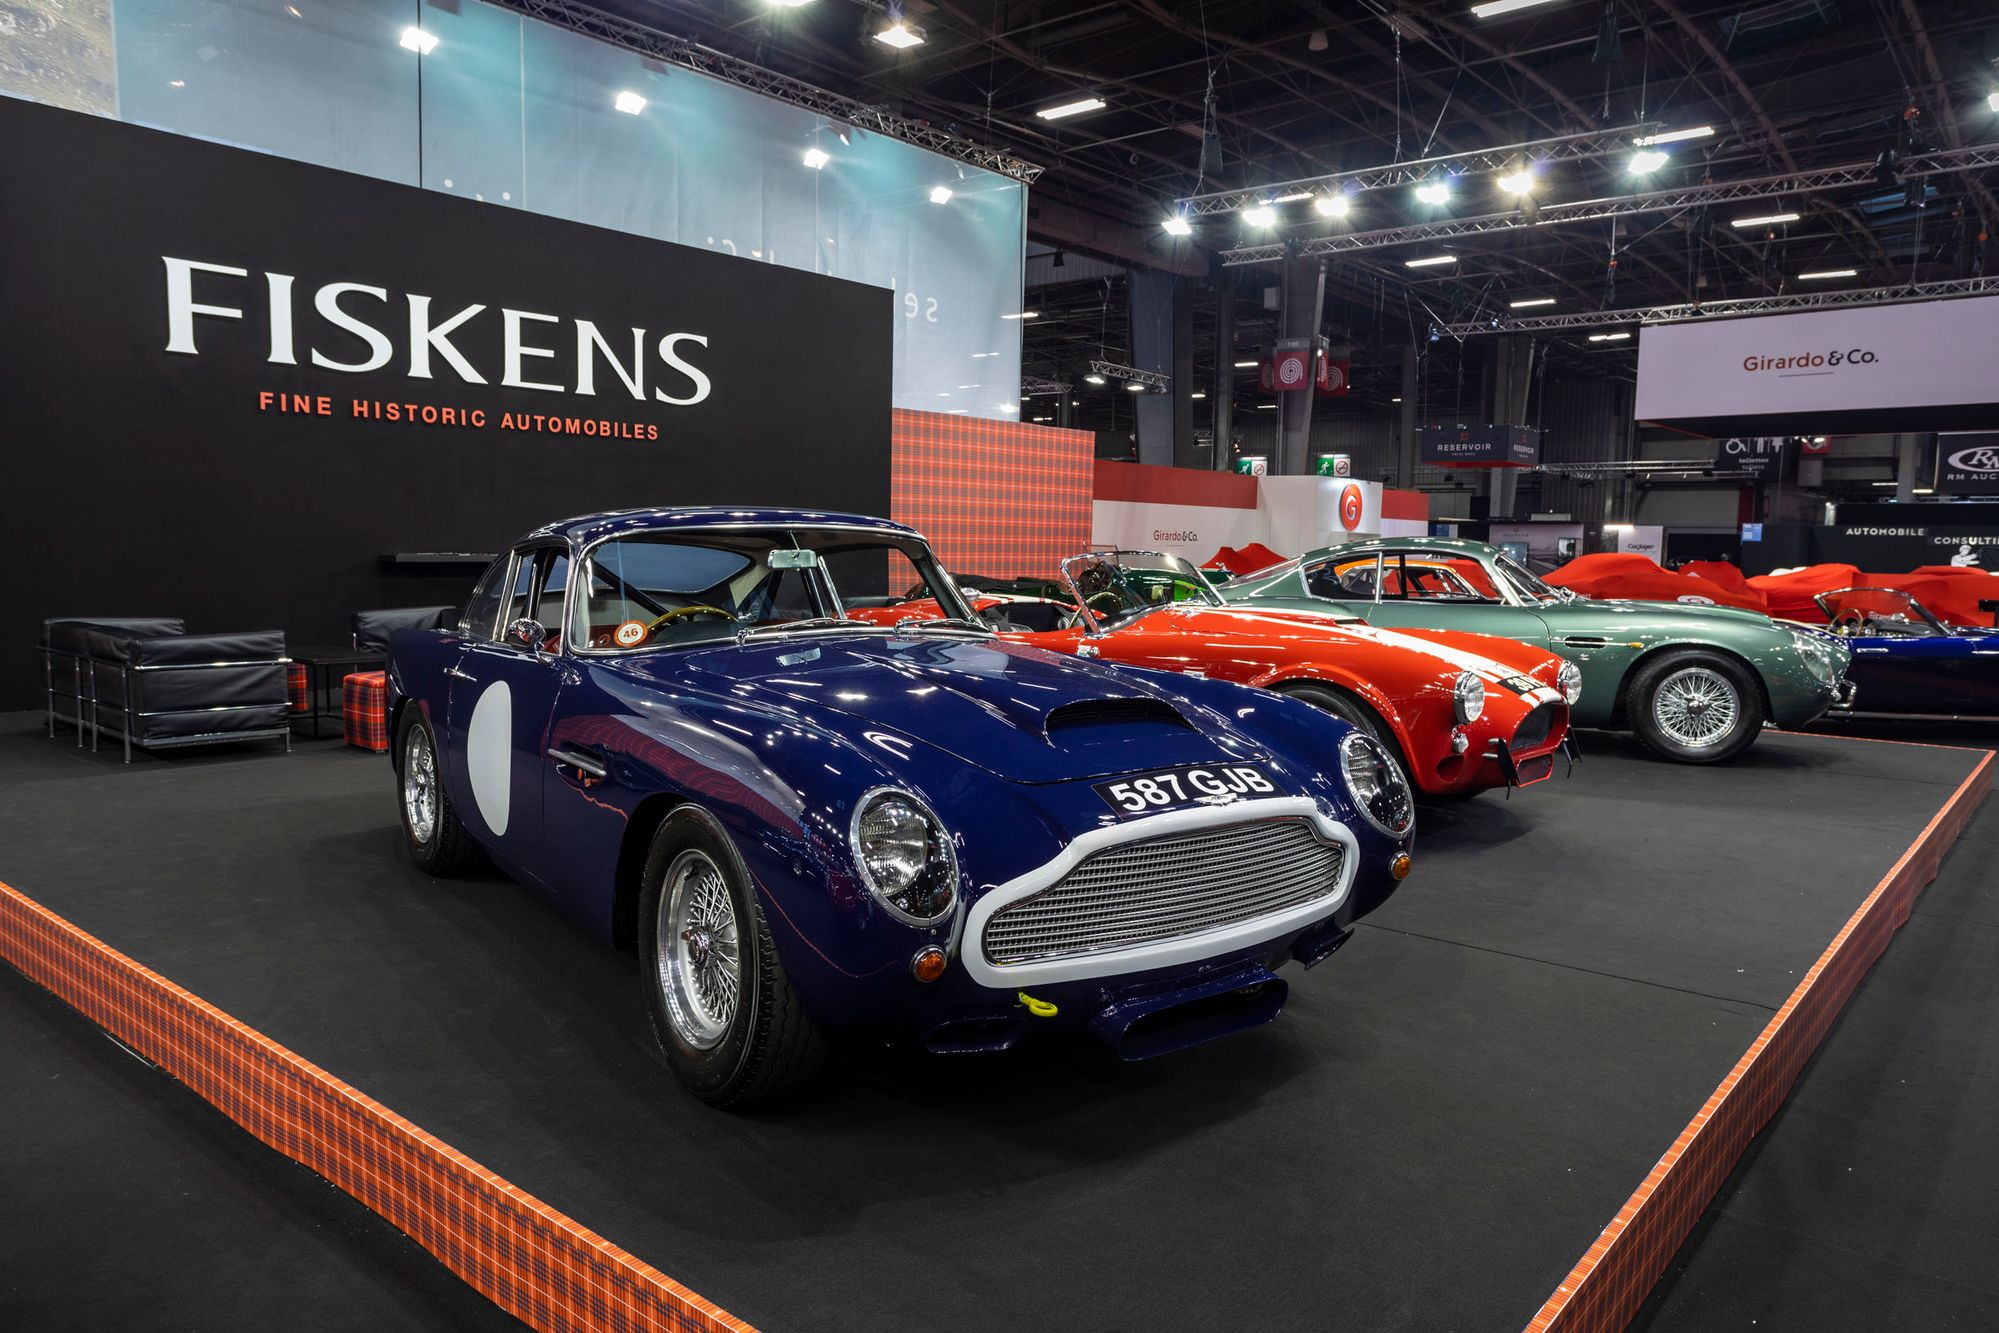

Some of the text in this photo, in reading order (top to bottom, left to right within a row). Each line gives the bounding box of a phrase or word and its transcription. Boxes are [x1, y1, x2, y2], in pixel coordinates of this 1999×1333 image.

[161, 255, 711, 406] FISKENS
[1743, 352, 1825, 372] Girardo
[259, 391, 659, 440] FINE HISTORIC AUTOMOBILES
[1437, 443, 1492, 452] RESERVOIR
[1947, 473, 1999, 481] RM AUC
[1153, 530, 1182, 542] Girardo
[1845, 527, 1925, 536] AUTOMOBILE
[623, 628, 638, 638] 46
[1109, 768, 1275, 812] 587 GJB
